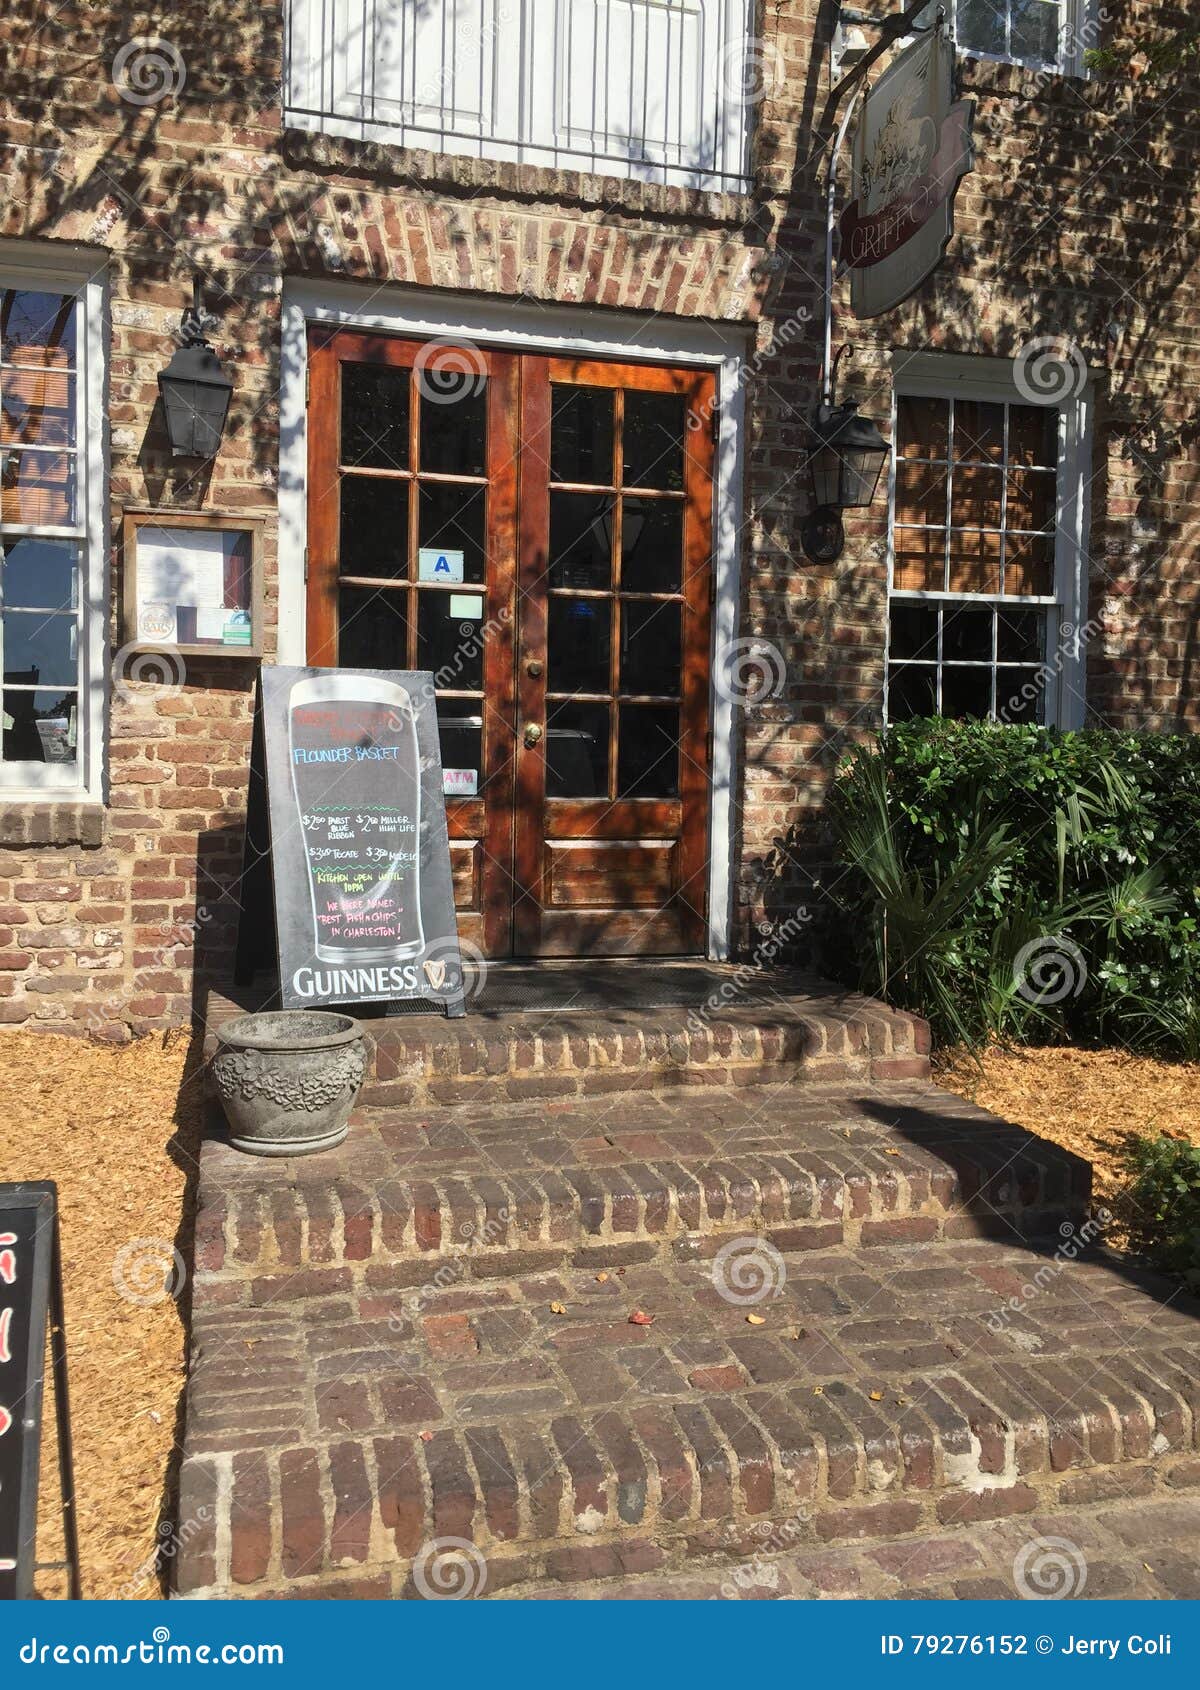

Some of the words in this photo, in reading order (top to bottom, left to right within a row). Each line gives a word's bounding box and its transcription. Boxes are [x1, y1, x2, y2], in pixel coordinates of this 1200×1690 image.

[434, 555, 451, 573] A
[294, 748, 353, 765] FLOUNDER
[355, 746, 400, 761] BASKET
[444, 772, 474, 783] ATM
[381, 815, 409, 824] MILLER
[400, 824, 416, 832] LIFE
[328, 831, 355, 840] RIBBON
[317, 872, 349, 884] KITCHEN
[354, 873, 373, 883] OPEN
[344, 883, 364, 893] 10PM
[327, 901, 338, 912] WE
[331, 927, 341, 937] IN
[293, 966, 418, 997] GUINNESS
